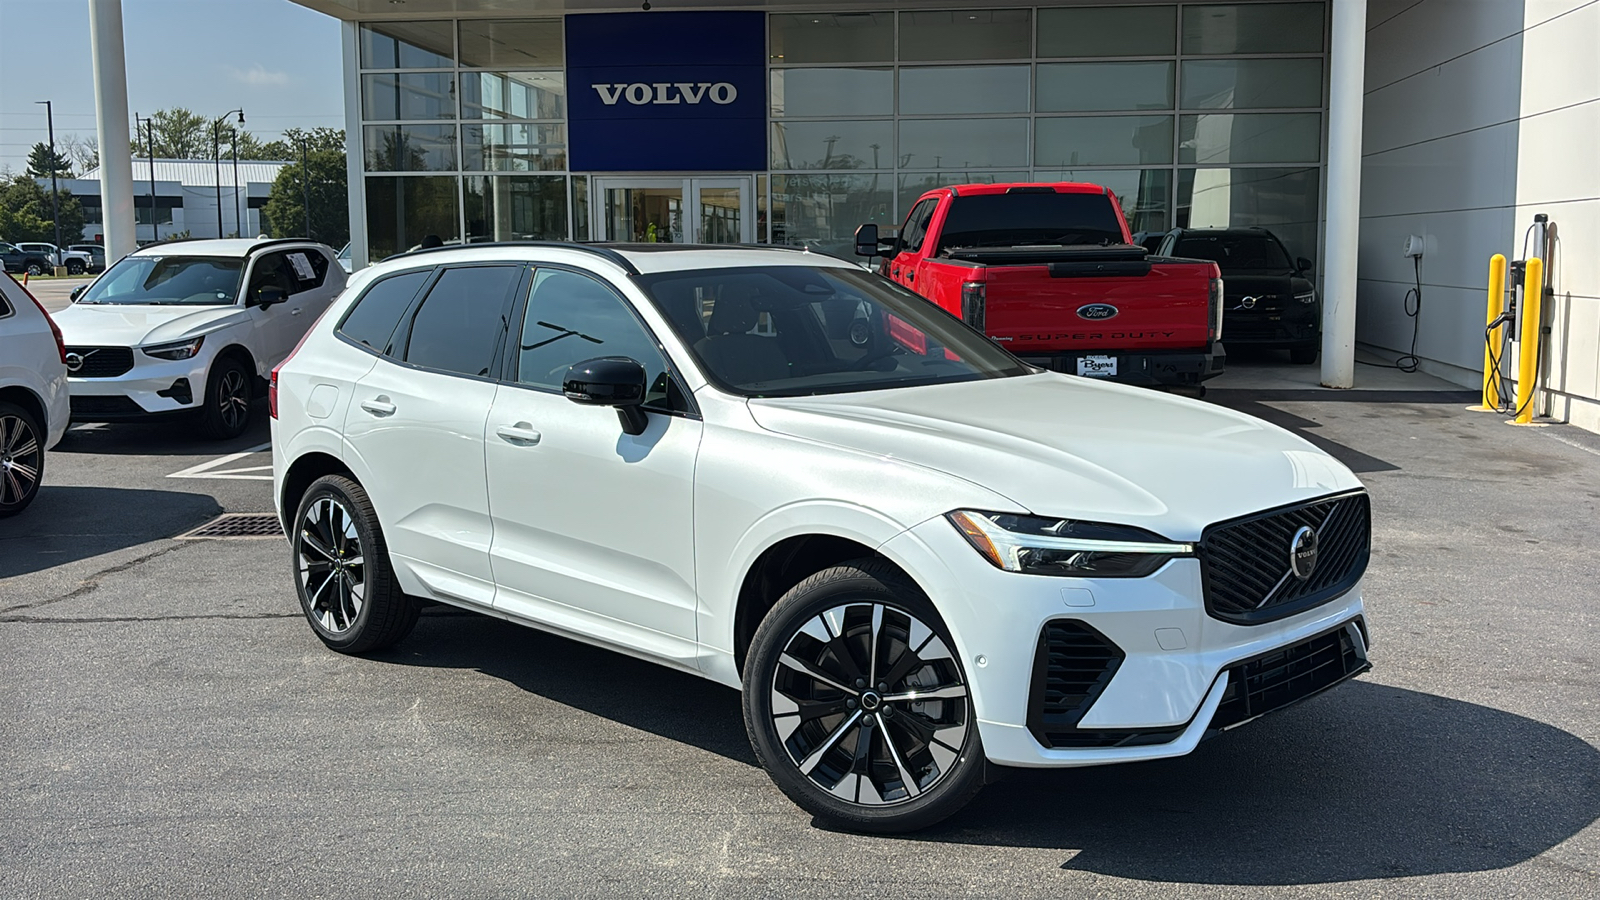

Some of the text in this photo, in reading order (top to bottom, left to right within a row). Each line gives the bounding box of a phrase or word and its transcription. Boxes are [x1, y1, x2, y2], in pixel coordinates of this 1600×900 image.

[592, 82, 738, 105] VOLVO
[1086, 307, 1109, 317] Ford
[1019, 331, 1175, 341] SUPER DUTY
[1080, 359, 1114, 371] Byers
